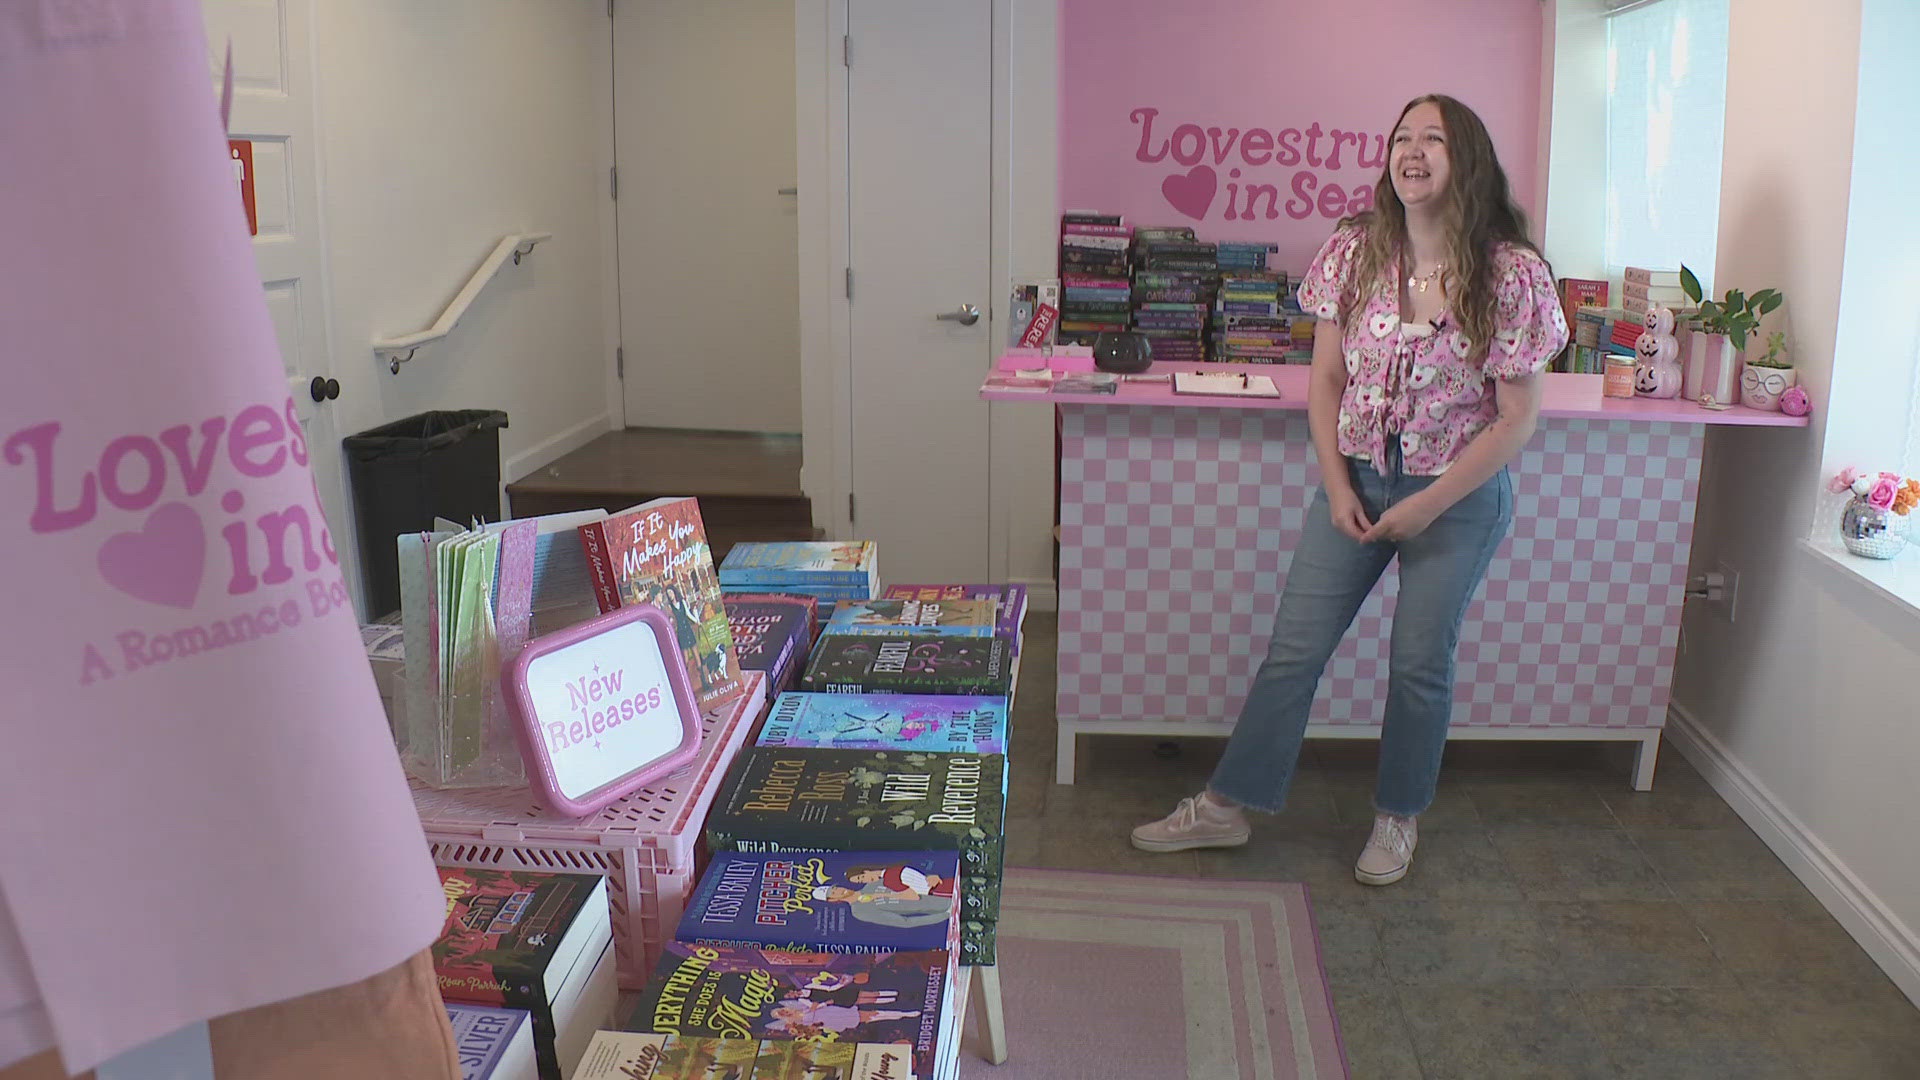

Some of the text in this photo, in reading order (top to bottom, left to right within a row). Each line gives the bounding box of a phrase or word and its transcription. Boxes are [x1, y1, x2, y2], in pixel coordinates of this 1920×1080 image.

[1129, 107, 1385, 172] Lovestru
[1223, 168, 1281, 221] in
[220, 488, 322, 596] in
[622, 520, 695, 582] Makes You
[631, 511, 664, 544] If It
[663, 541, 703, 580] Happy
[79, 642, 114, 686] A
[115, 598, 302, 674] Romance
[565, 667, 624, 712] New
[703, 690, 719, 702] JULIE
[776, 694, 804, 722] DIXON
[547, 686, 662, 753] Releases
[948, 728, 968, 743] BY
[951, 710, 972, 728] THE
[972, 709, 997, 744] HORNS
[743, 759, 807, 812] Rebecca
[798, 771, 850, 801] Ross
[880, 773, 932, 802] Wild
[927, 758, 982, 825] Reverence
[717, 859, 759, 894] BAILEY
[755, 860, 794, 926] PITCHER
[783, 858, 826, 915] Perfect
[701, 891, 744, 925] TESSA
[436, 975, 512, 992] Roan Parrish
[687, 971, 722, 1026] SHE DOES IS
[707, 968, 779, 1040] Magic
[917, 966, 942, 1052] BRIDGET MORRISSEY
[459, 1016, 509, 1067] SILVER
[620, 1043, 672, 1080] hing
